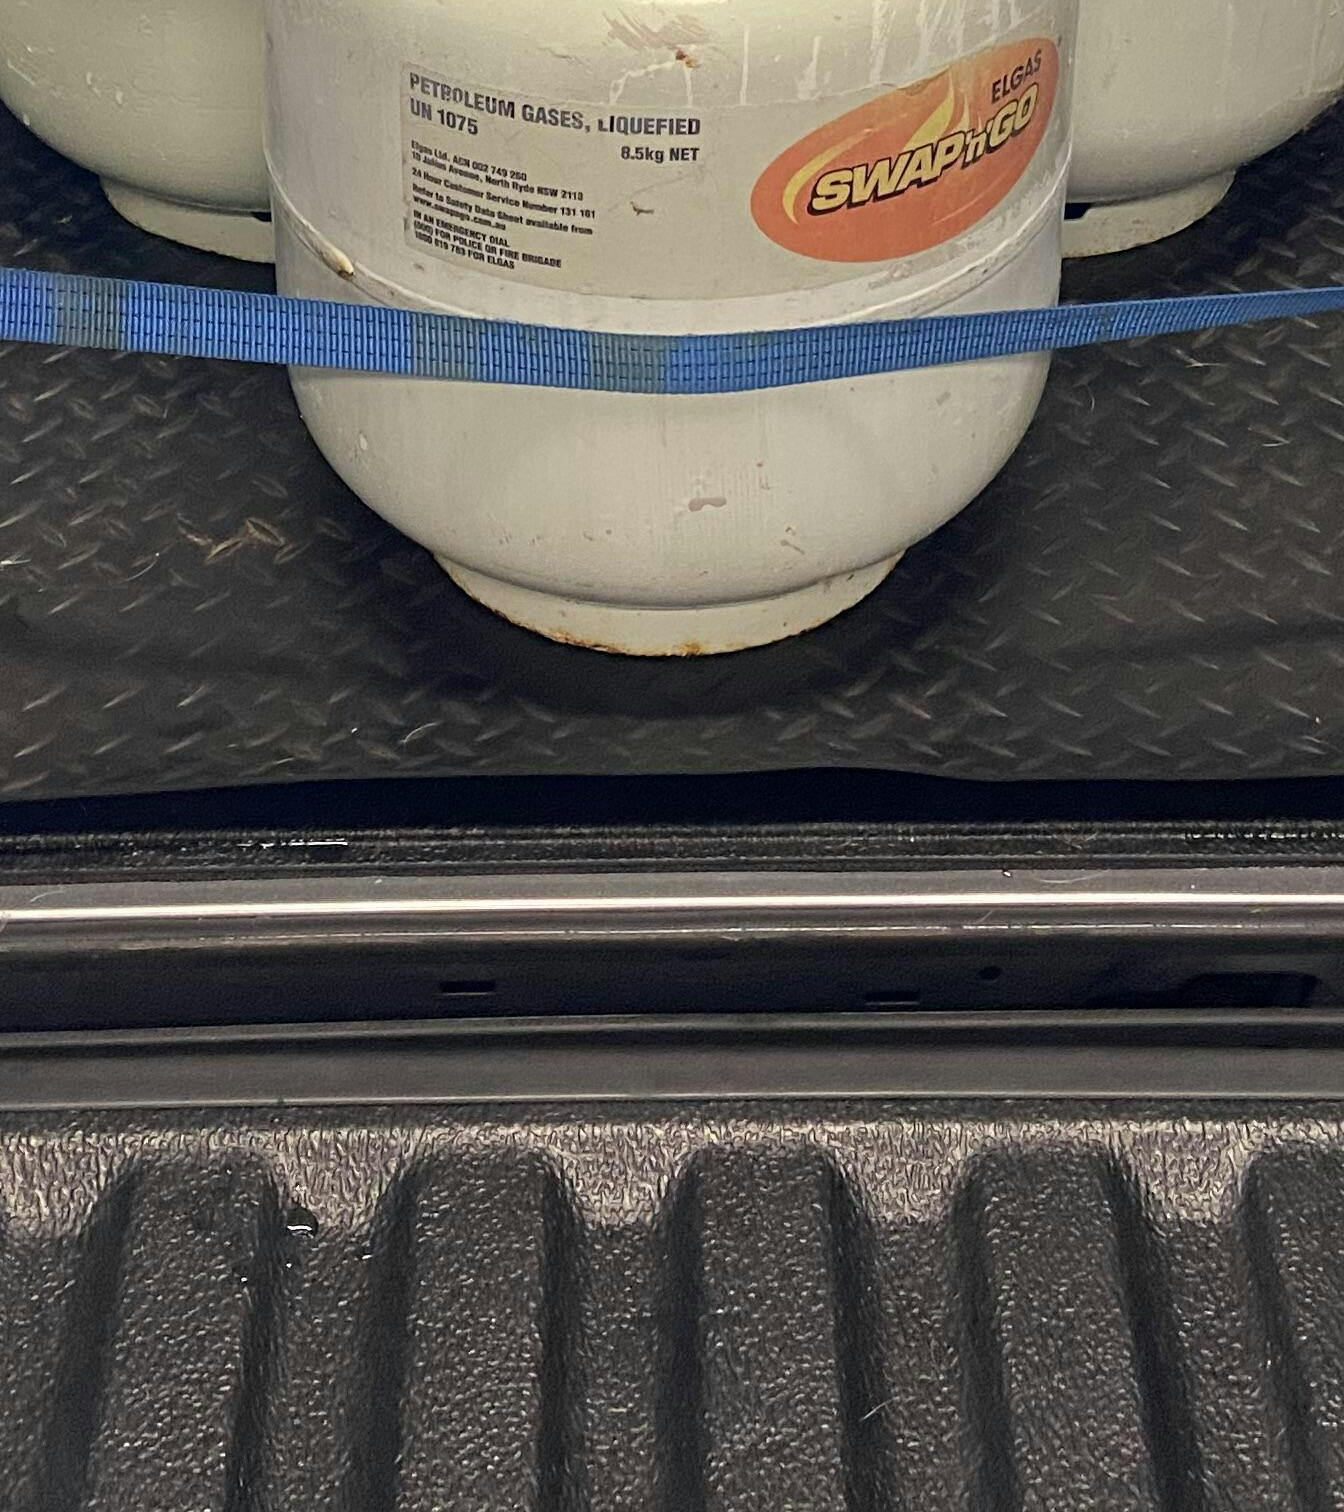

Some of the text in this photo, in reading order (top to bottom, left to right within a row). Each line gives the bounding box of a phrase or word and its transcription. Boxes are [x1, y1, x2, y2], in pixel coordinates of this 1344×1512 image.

[992, 50, 1042, 104] ELGAS
[409, 72, 700, 135] PETROLEUM GASES, LIQUEFIED
[409, 98, 479, 136] UN 1075
[620, 146, 701, 164] 8.5kg NET
[412, 167, 422, 179] 24
[485, 191, 521, 208] Service
[560, 206, 577, 217] 131
[423, 213, 435, 225] AN
[435, 218, 487, 243] EMERGENCY
[435, 227, 451, 242] FOR
[452, 234, 483, 251] POLICE
[521, 253, 562, 269] BRIGADE
[467, 249, 486, 263] FOR
[487, 254, 515, 270] ELGAS
